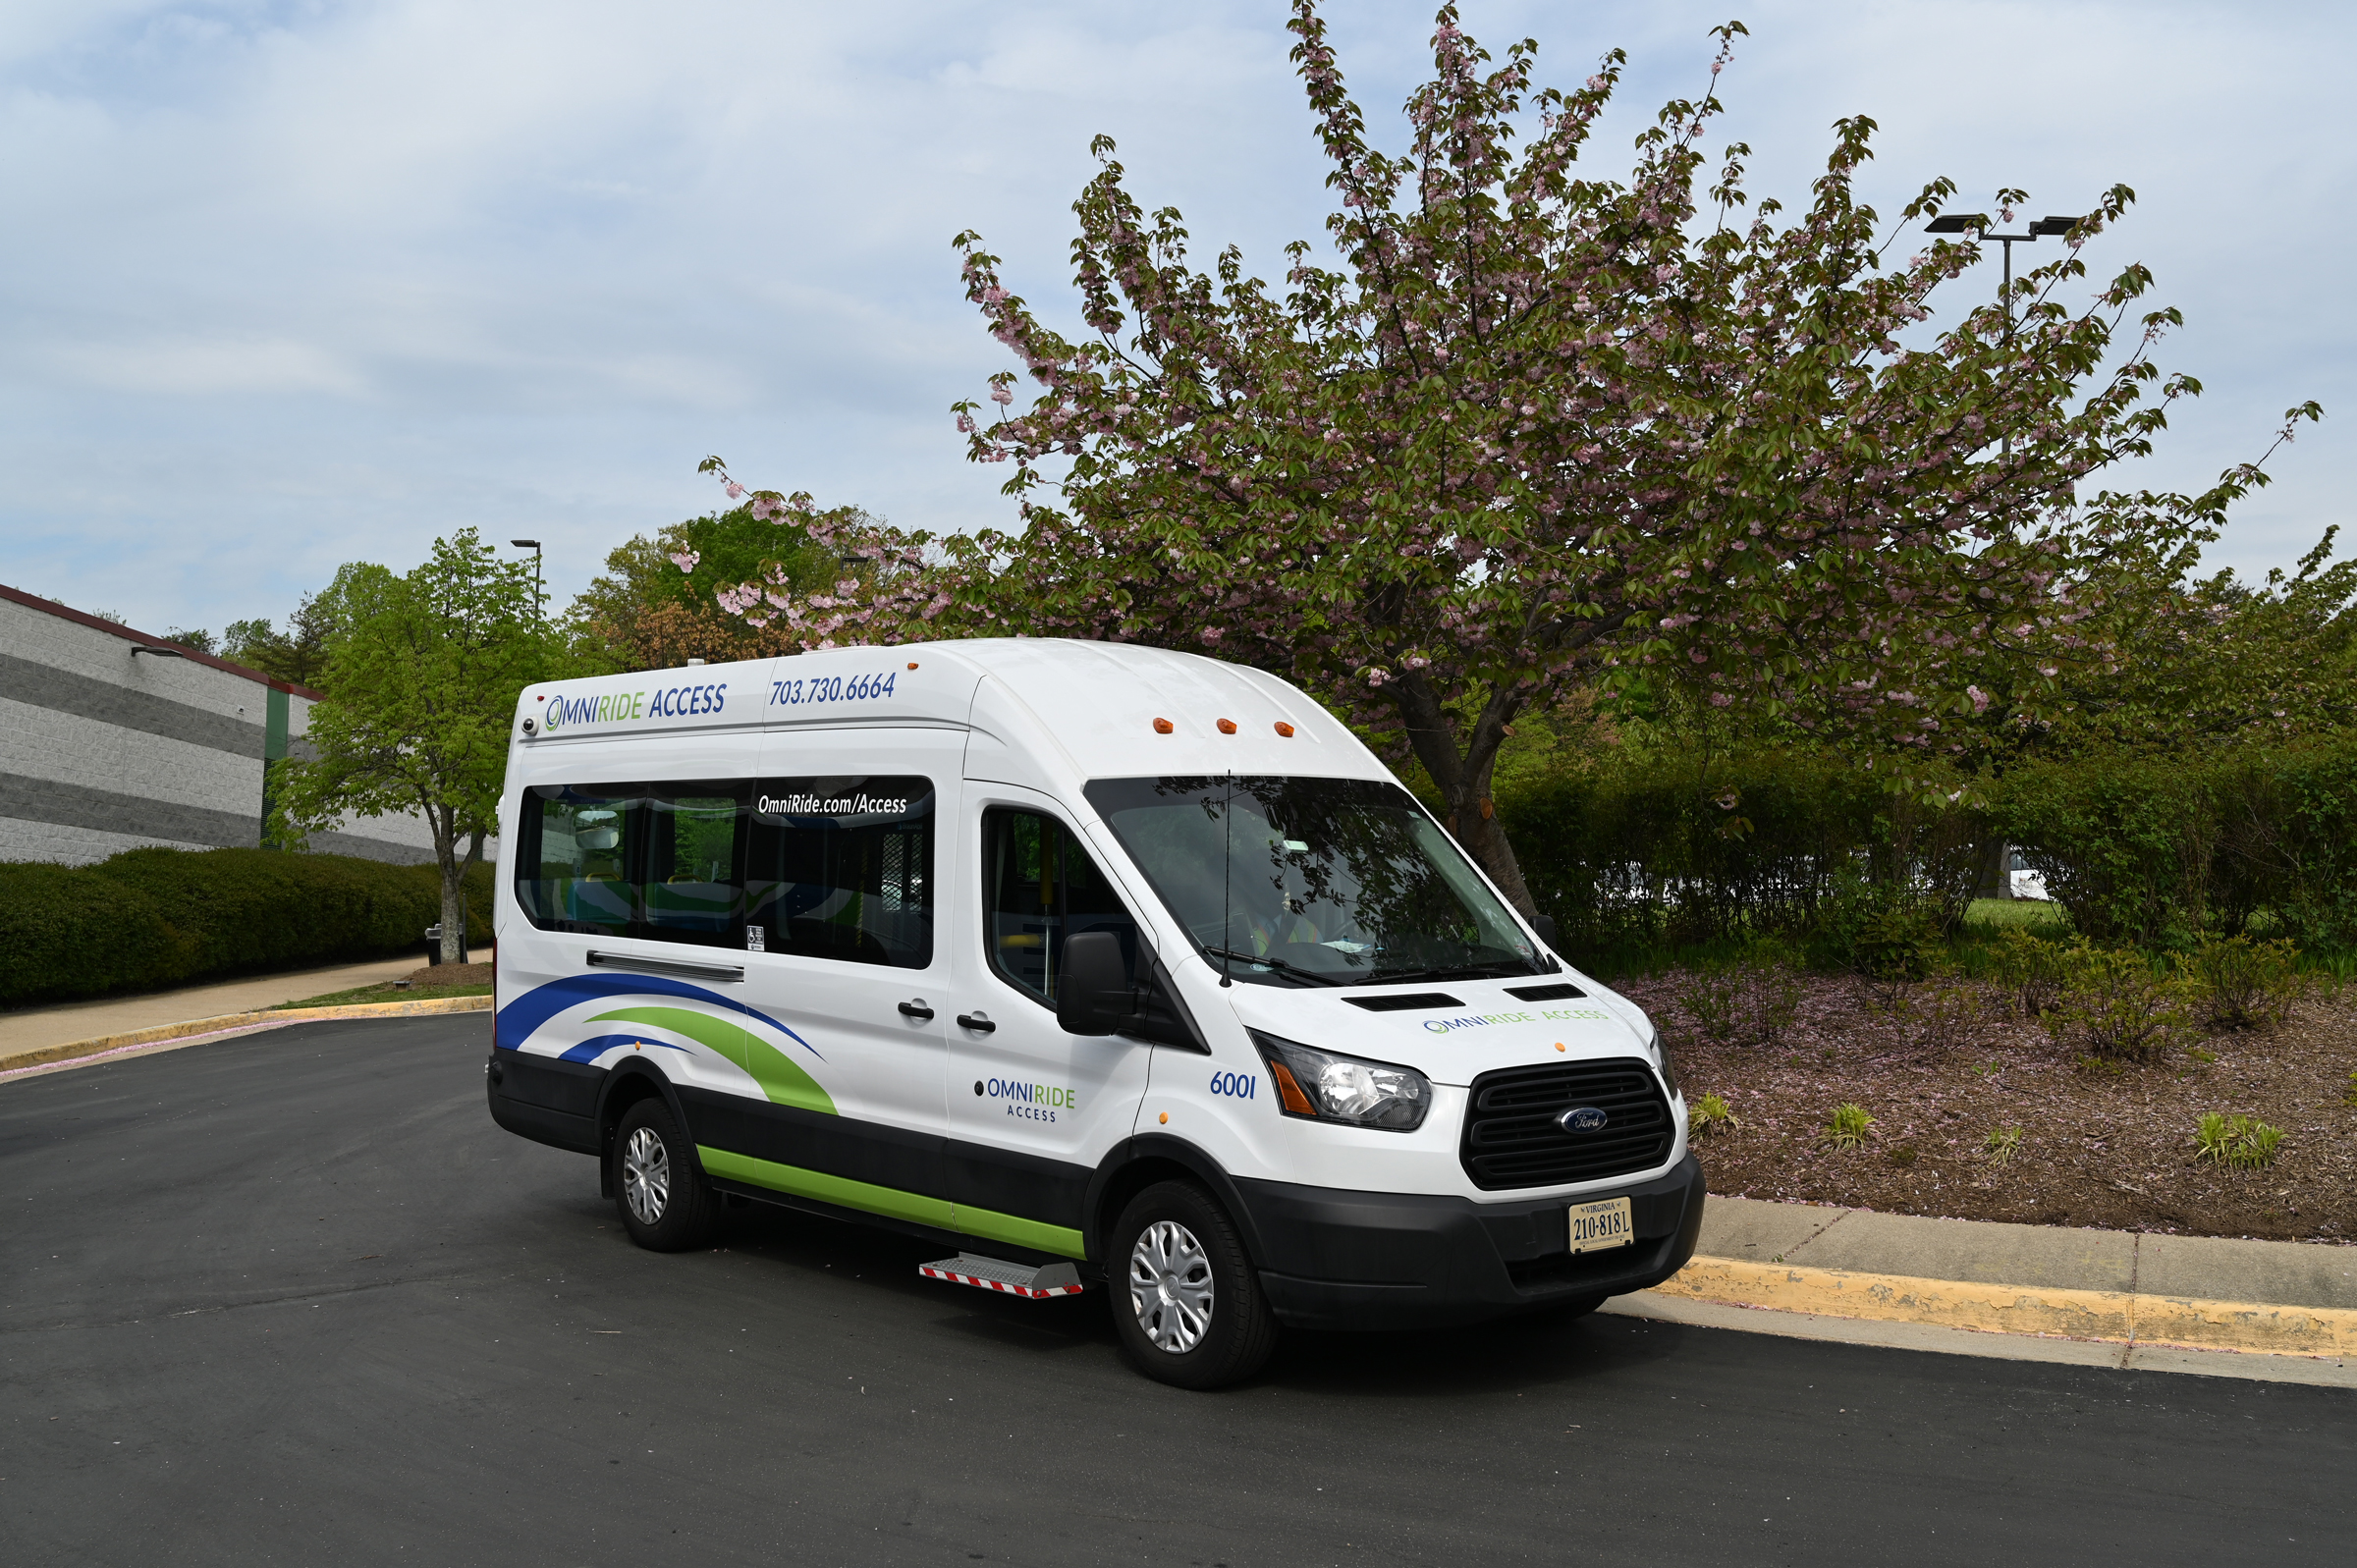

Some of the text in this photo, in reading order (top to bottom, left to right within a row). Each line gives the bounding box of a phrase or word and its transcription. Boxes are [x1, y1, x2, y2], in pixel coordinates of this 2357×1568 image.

[770, 673, 896, 705] 703.730.6664
[544, 683, 727, 731] OMNIRIDE ACCESS
[758, 793, 906, 814] OmniRide.com/Access
[1422, 1010, 1609, 1034] OMNIRIDE ACCESS
[988, 1078, 1075, 1108] OMNIRIDE
[1210, 1071, 1256, 1100] 6001
[1007, 1106, 1056, 1123] ACCESS
[1575, 1111, 1600, 1129] Ford
[1586, 1202, 1616, 1214] VIRGINIA
